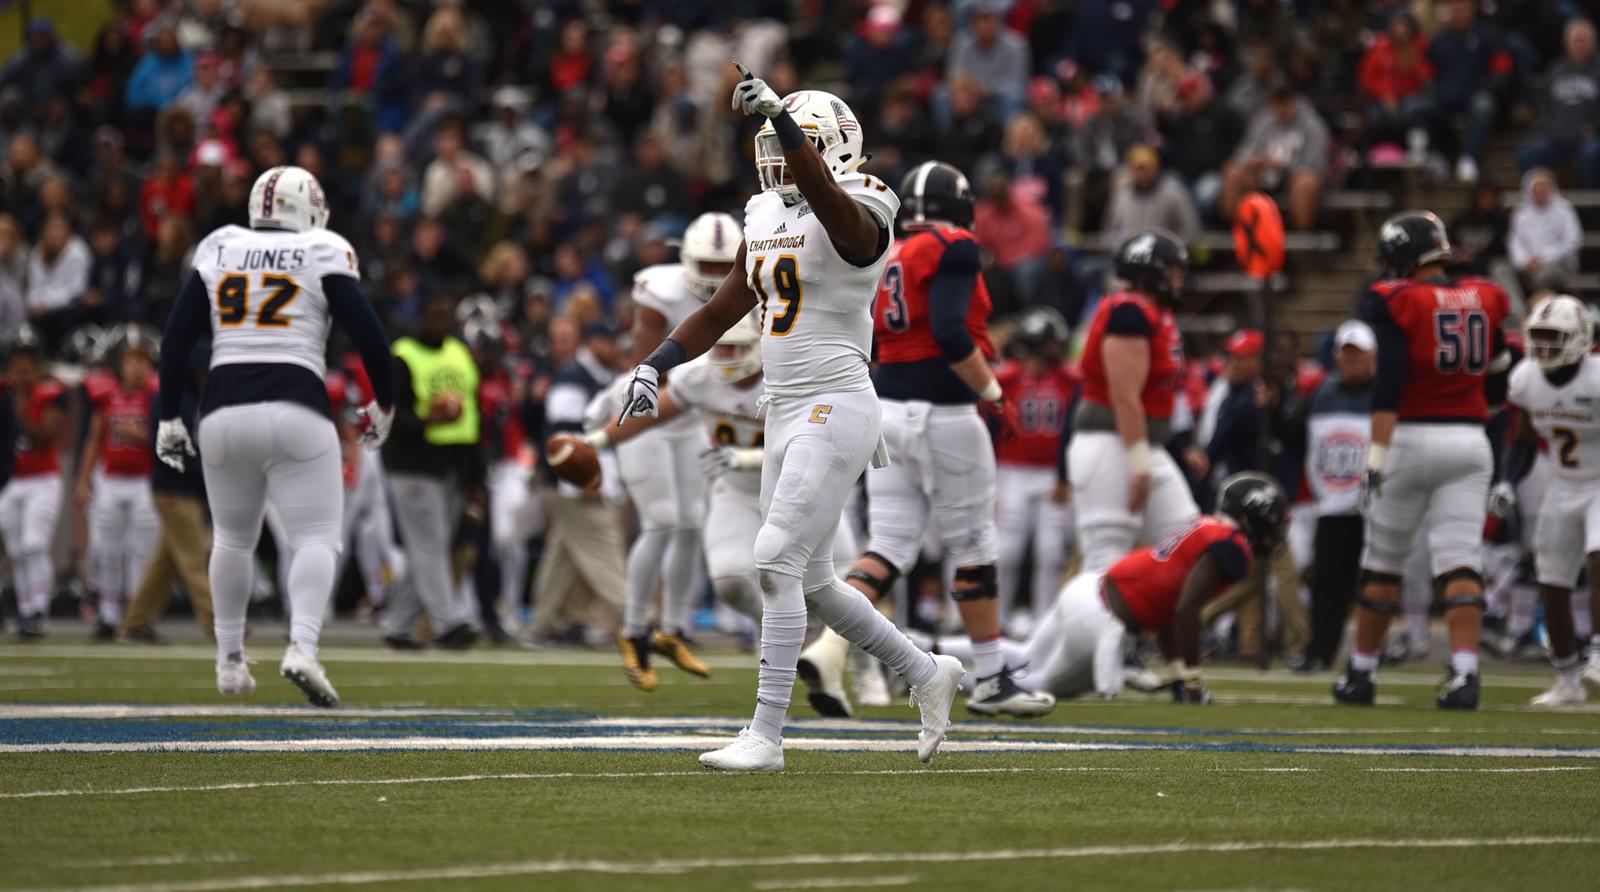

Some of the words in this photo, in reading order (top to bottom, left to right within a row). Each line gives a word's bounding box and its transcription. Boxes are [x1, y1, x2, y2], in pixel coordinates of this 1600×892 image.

[216, 246, 227, 269] T.
[237, 248, 306, 271] JONES
[750, 234, 806, 252] CHATTANOOGA
[216, 273, 301, 328] 92
[748, 254, 803, 336] 19
[1433, 308, 1490, 376] 50
[808, 404, 833, 425] C
[1552, 424, 1580, 470] 2
